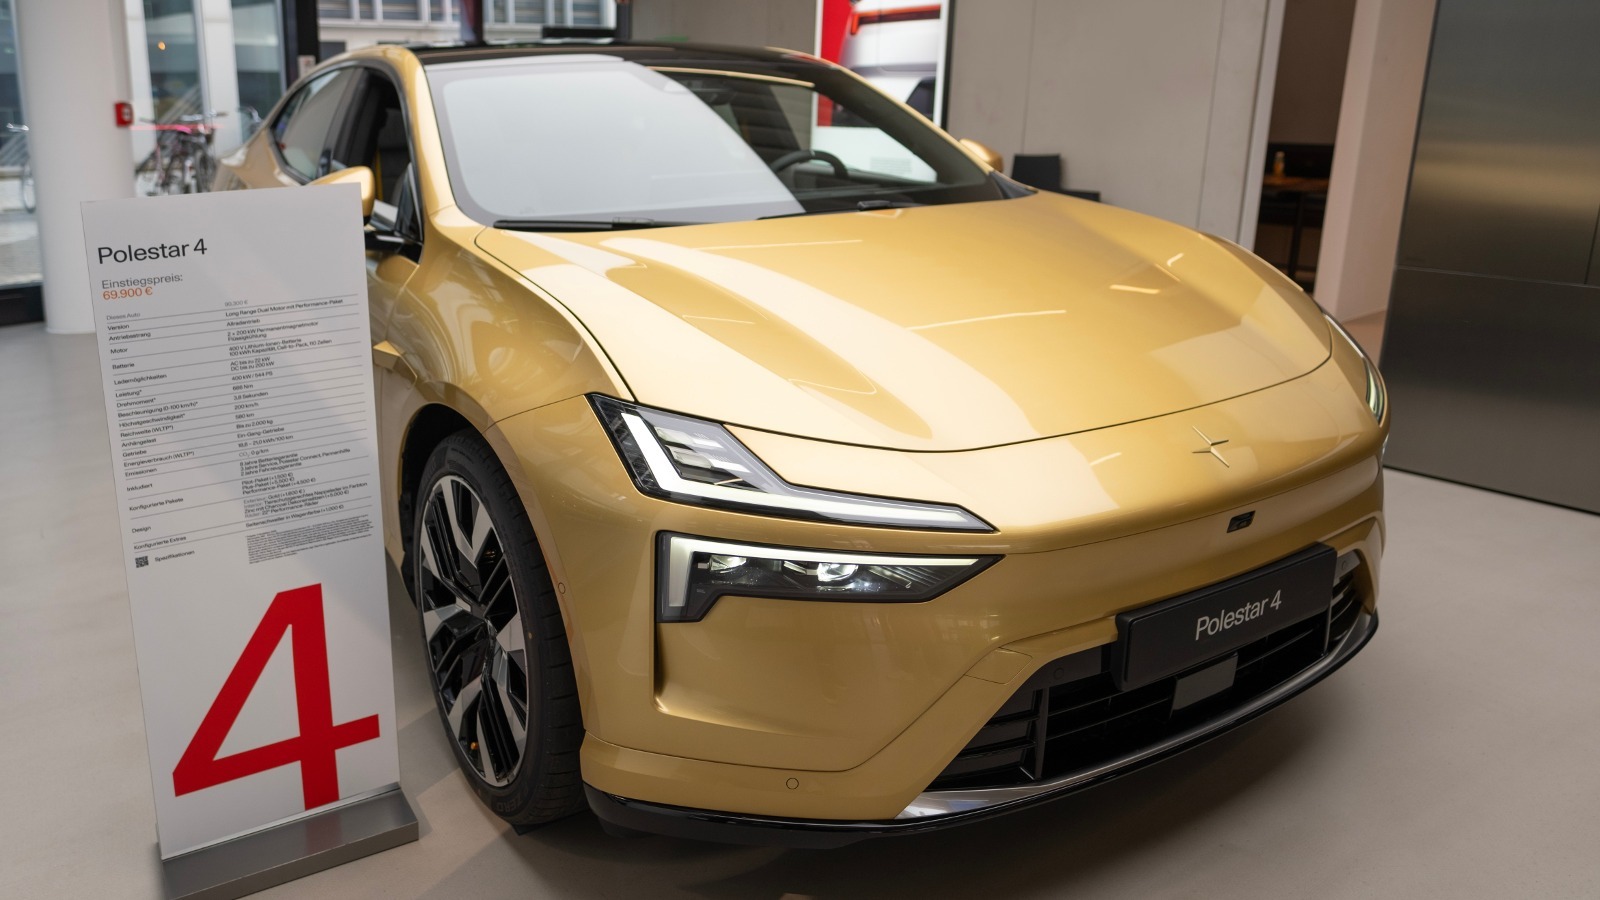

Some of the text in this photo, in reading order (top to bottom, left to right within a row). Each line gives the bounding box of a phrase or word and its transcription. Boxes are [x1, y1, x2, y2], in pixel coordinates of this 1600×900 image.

[97, 238, 208, 264] Polestar 4
[101, 273, 184, 289] Einstiegspreis:
[102, 286, 153, 301] 69.900 €
[295, 299, 343, 308] Performance-Paket
[227, 319, 260, 327] Allradantrieb
[257, 322, 318, 333] Permanentmagnetmotor
[114, 374, 167, 385] Lademöglichkeiten
[118, 407, 163, 418] Beschleunigung
[120, 429, 151, 438] Reichweite
[237, 427, 284, 439] Ein-Gang-Getriebe
[124, 455, 172, 467] Energieverbrauch
[125, 468, 157, 477] Emissionen
[127, 483, 153, 492] Inkludiert
[242, 482, 291, 495] Performance-Paket
[129, 501, 165, 511] Konfigurierte
[134, 540, 169, 550] Konfigurierte
[155, 550, 195, 562] Spezifikationen
[1195, 589, 1282, 641] Polestar 4
[172, 582, 380, 811] 4
